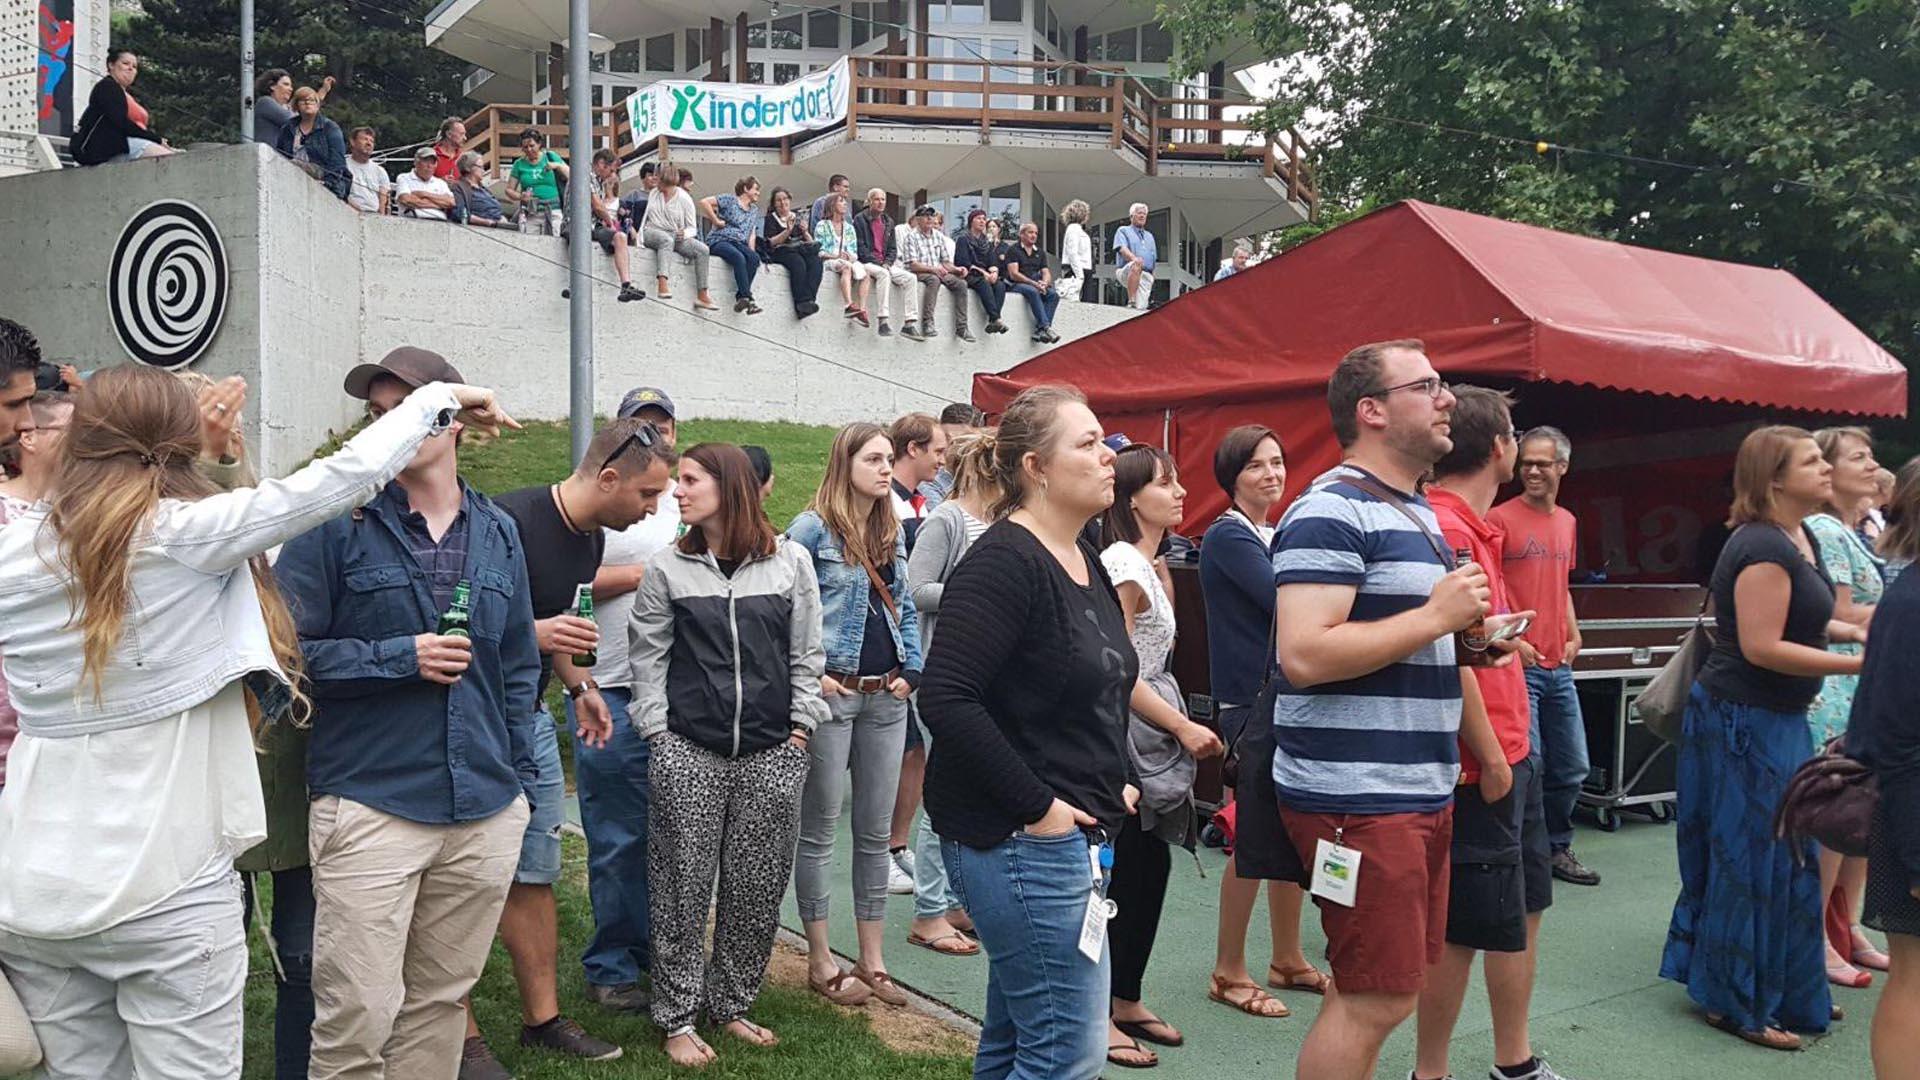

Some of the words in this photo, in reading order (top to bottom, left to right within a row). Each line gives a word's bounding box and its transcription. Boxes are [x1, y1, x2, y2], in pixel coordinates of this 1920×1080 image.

[632, 92, 648, 137] 45
[669, 74, 836, 131] Kinderdorf
[1577, 496, 1704, 576] la
